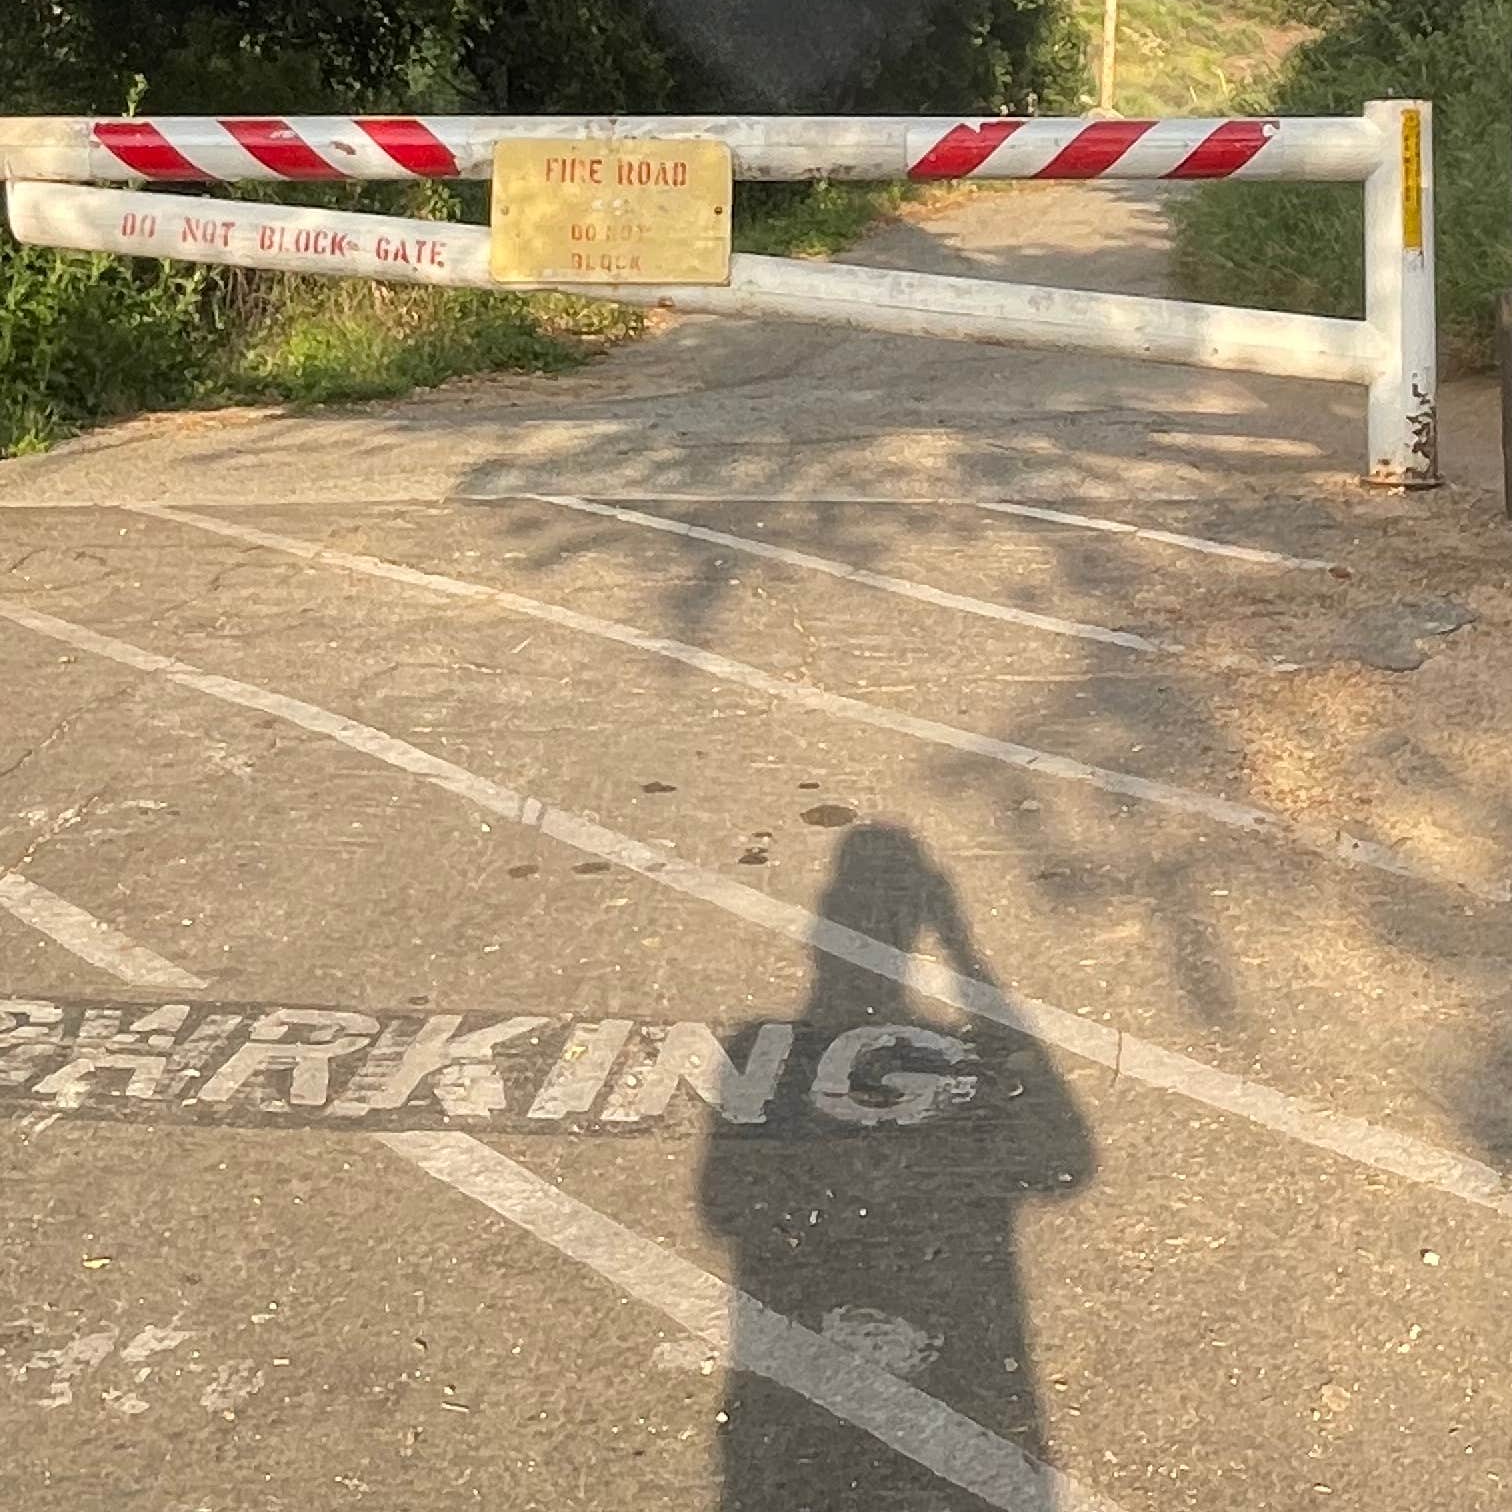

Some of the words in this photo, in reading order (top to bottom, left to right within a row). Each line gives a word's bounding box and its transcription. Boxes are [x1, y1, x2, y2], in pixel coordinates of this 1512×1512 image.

[545, 157, 602, 184] FIRE
[617, 161, 687, 186] ROAD
[121, 212, 156, 238] DO
[181, 216, 236, 247] NOT
[259, 225, 349, 256] BLOCK
[375, 237, 446, 268] GATE
[570, 223, 597, 242] DO
